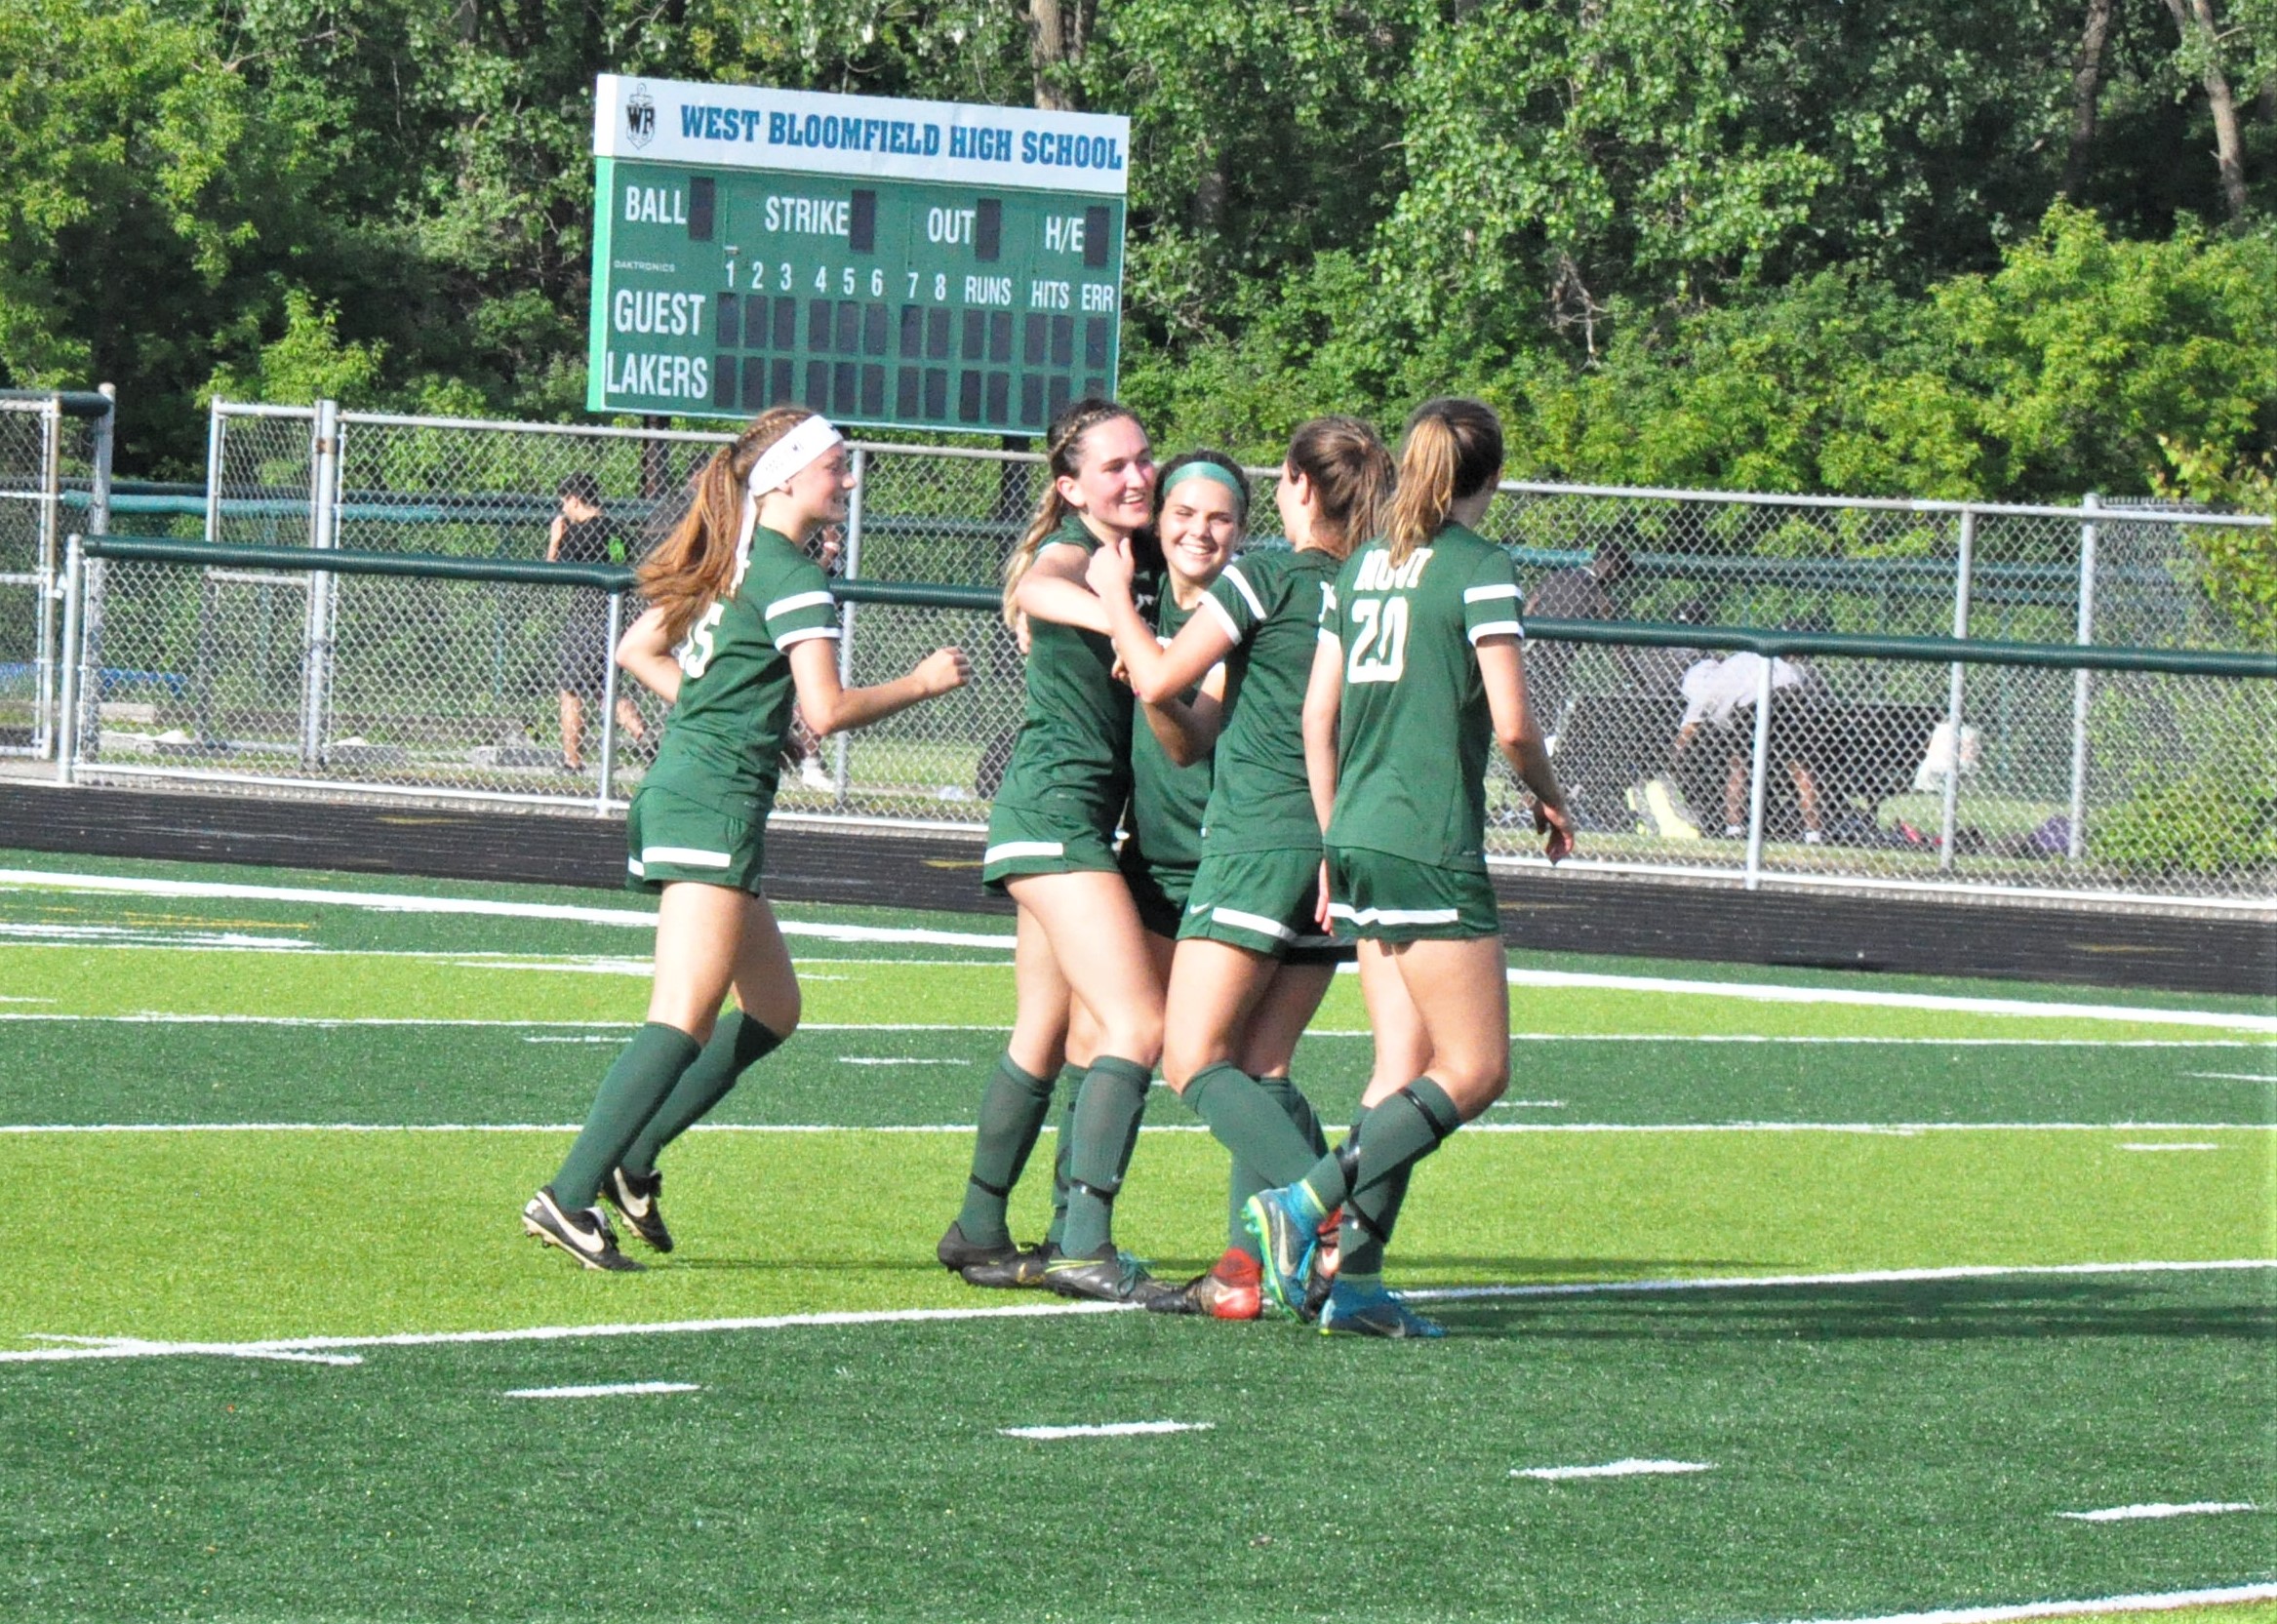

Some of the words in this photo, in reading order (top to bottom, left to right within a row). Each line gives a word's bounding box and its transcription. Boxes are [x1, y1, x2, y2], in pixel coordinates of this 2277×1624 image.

[680, 104, 760, 142] WEST
[768, 111, 939, 157] BLOOMFIELD
[949, 125, 1013, 163] HIGH
[1021, 130, 1123, 170] SCHOOL
[624, 185, 687, 225] BALL
[765, 195, 851, 236] STRIKE
[927, 208, 976, 244] OUT
[1045, 216, 1085, 254] H/E
[615, 289, 705, 337] GUEST
[725, 261, 736, 287] 1
[751, 261, 764, 290] 2
[779, 262, 792, 291] 3
[815, 265, 827, 294] 4
[842, 266, 856, 295] 5
[871, 268, 884, 297] 6
[906, 271, 918, 299] 7
[934, 272, 946, 300] 8
[965, 275, 1013, 305] RUNS
[1031, 280, 1071, 310] HITS
[1081, 284, 1114, 312] ERR
[605, 350, 708, 399] LAKERS
[1347, 596, 1409, 684] 20
